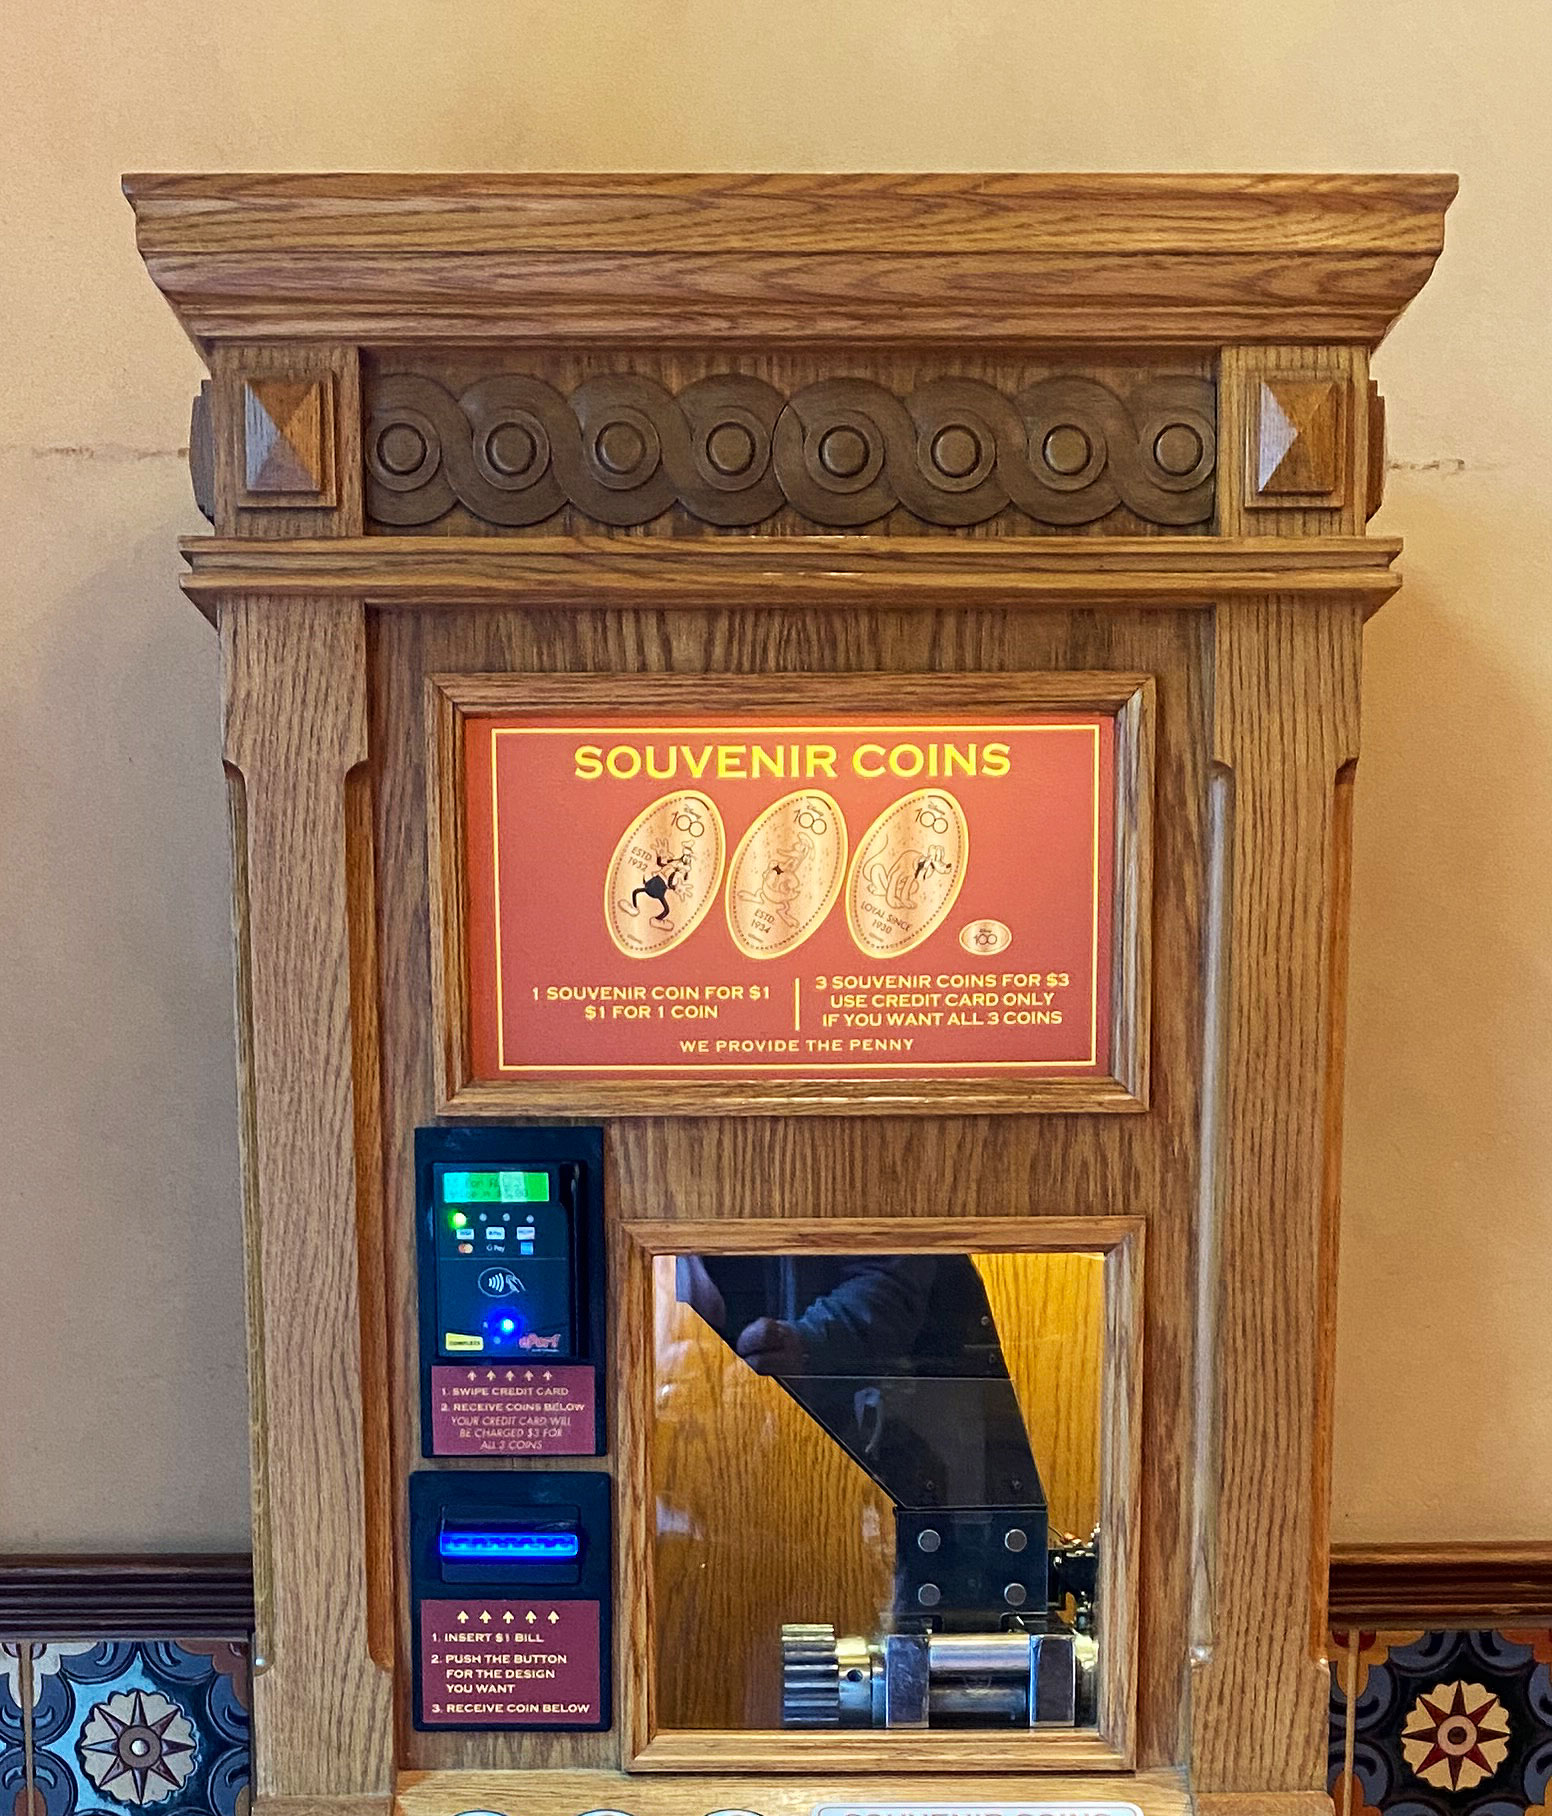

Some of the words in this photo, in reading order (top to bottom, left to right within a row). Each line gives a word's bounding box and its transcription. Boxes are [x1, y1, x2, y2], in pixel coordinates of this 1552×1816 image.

[574, 743, 837, 780] SOUVENIR
[852, 743, 1011, 777] COINS
[915, 807, 949, 834] 100
[627, 856, 648, 872] 1932
[860, 900, 885, 919] LOYAL
[886, 913, 913, 932] SINCE
[872, 919, 893, 935] 1930
[815, 976, 828, 990] 3
[832, 975, 931, 990] SOUVENIR
[937, 974, 997, 988] COINS
[1002, 974, 1040, 988] FOR
[1045, 972, 1069, 989] $3
[532, 986, 539, 1000] 1
[547, 986, 647, 1000] SOUVENIR
[651, 986, 699, 1000] COIN
[705, 986, 744, 1000] FOR
[749, 986, 770, 1000] $1
[830, 994, 868, 1009] USE
[871, 994, 941, 1008] CREDIT
[944, 993, 999, 1007] CARD
[1002, 992, 1055, 1006] ONLY
[584, 1005, 605, 1019] $1
[612, 1005, 651, 1019] FOR
[657, 1005, 664, 1019] 1
[671, 1005, 718, 1019] COIN
[822, 1013, 838, 1027] IF
[841, 1013, 883, 1027] YOU
[886, 1012, 944, 1026] WANT
[946, 1012, 984, 1026] ALL
[987, 1011, 1000, 1025] 3
[1003, 1010, 1063, 1025] COINS
[680, 1039, 709, 1053] WE
[715, 1039, 800, 1053] PROVIDE
[806, 1039, 843, 1052] THE
[849, 1038, 914, 1051] PENNY
[452, 1387, 489, 1396] SWIPE
[492, 1387, 533, 1396] CREDIT
[536, 1387, 569, 1396] CARD
[453, 1403, 503, 1411] RECEIVE
[506, 1403, 541, 1411] COINS
[544, 1403, 585, 1411] BELOW
[451, 1416, 478, 1425] YOUR
[482, 1416, 516, 1425] CREDIT
[519, 1416, 547, 1425] CARD
[549, 1416, 571, 1425] WILL
[459, 1428, 471, 1438] BE
[474, 1428, 524, 1438] CHARGED
[527, 1428, 539, 1438] $3
[543, 1428, 563, 1438] FOR
[480, 1440, 496, 1450] ALL
[508, 1440, 543, 1450] COINS
[432, 1632, 441, 1643] 1.
[445, 1632, 491, 1643] INSERT
[495, 1632, 510, 1643] $1
[515, 1632, 544, 1643] BILL
[431, 1654, 442, 1664] 2.
[445, 1654, 481, 1664] PUSH
[484, 1654, 510, 1664] THE
[514, 1654, 567, 1664] BUTTON
[446, 1669, 473, 1679] FOR
[475, 1669, 502, 1679] THE
[505, 1669, 555, 1679] DESIGN
[446, 1684, 473, 1693] YOU
[476, 1684, 516, 1693] WANT
[432, 1703, 443, 1714] 3.
[446, 1703, 503, 1714] RECEIVE
[507, 1703, 539, 1714] COIN
[542, 1703, 590, 1714] BELOW
